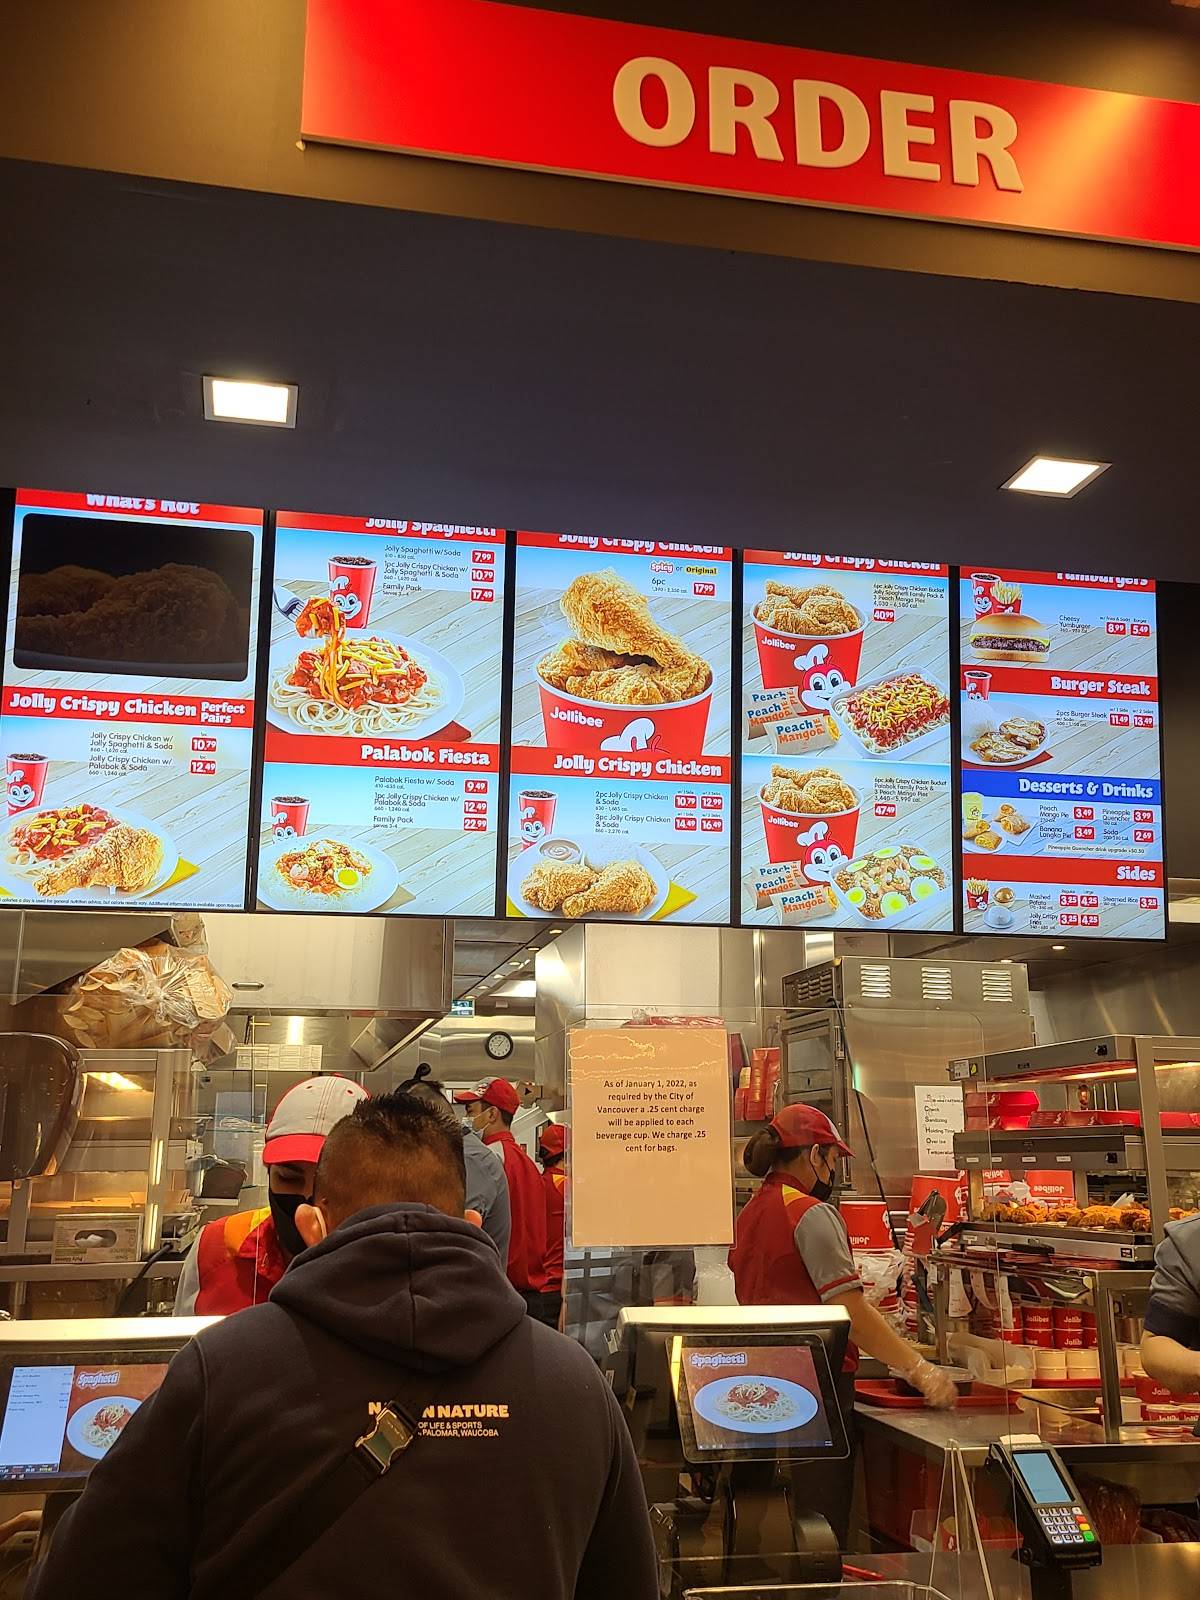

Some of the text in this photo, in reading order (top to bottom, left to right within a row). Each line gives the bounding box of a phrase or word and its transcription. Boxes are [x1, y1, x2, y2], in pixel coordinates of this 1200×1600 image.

[613, 56, 1024, 192] ORDER
[475, 552, 491, 562] 7.99
[400, 569, 432, 577] Spaghetti
[472, 570, 493, 580] 10.79
[652, 577, 666, 586] 6pc
[382, 583, 404, 591] Family
[694, 584, 713, 594] 17.99
[472, 590, 492, 600] 17.49
[874, 610, 893, 620] 40.99
[1060, 615, 1080, 624] Cheesy
[1108, 623, 1124, 633] 8.99
[1133, 625, 1148, 634] 5.49
[761, 636, 796, 651] Jollibee
[1051, 677, 1150, 696] Burger Steak
[10, 693, 197, 717] Jolly Crispy Chicken
[201, 702, 245, 715] Perfect
[748, 703, 781, 718] Peach
[201, 713, 232, 724] Pairs
[550, 707, 603, 728] Jollibee
[750, 710, 784, 726] Mango
[1111, 715, 1128, 724] 11.49
[1134, 716, 1152, 726] 13.49
[776, 720, 813, 734] Peach
[91, 732, 106, 740] Jolly
[109, 732, 130, 741] Crispy
[133, 733, 161, 742] Chicken
[778, 729, 817, 743] Mango
[90, 740, 106, 748] Jolly
[108, 741, 145, 750] Spaghetti
[193, 739, 216, 750] 10.79
[361, 744, 490, 765] Palabok Fiesta
[89, 755, 105, 763] Jolly
[108, 756, 129, 765] Crispy
[132, 757, 160, 765] Chicken
[191, 762, 216, 773] 12.49
[554, 755, 722, 777] Jolly Crispy Chicken
[374, 776, 403, 784] Palabok
[404, 777, 425, 785] Fiesta
[437, 778, 455, 786] Soda
[467, 782, 485, 792] 9.49
[1019, 779, 1153, 799] Desserts & Drinks
[375, 792, 385, 800] 1pc
[386, 793, 402, 801] Jolly
[402, 794, 422, 802] Crispy
[595, 791, 607, 799] 2pc
[608, 792, 622, 800] Jolly
[623, 792, 645, 801] Crispy
[676, 797, 695, 806] 10.79
[702, 798, 721, 807] 12.99
[464, 802, 486, 813] 12.49
[876, 806, 895, 815] 47.49
[1076, 808, 1092, 818] 3.49
[1135, 811, 1151, 821] 3.99
[374, 816, 413, 824] Family Pack
[609, 814, 623, 822] Jolly
[625, 815, 645, 823] Crispy
[768, 816, 799, 828] Jollibee
[464, 819, 486, 830] 22.99
[676, 819, 695, 829] 14.49
[702, 820, 721, 830] 16.49
[1076, 828, 1092, 837] 3.49
[1136, 831, 1152, 841] 2.69
[1117, 866, 1156, 881] Sides
[756, 876, 785, 890] Peach
[781, 891, 814, 905] Peach
[1061, 896, 1077, 905] 3.25
[1081, 897, 1097, 906] 4.25
[1141, 898, 1156, 908] 3.25
[783, 899, 818, 913] Mango
[1061, 915, 1077, 924] 3.25
[1082, 916, 1097, 925] 4.25
[625, 1080, 655, 1089] January
[657, 1080, 664, 1088] 1,
[666, 1080, 686, 1088] 2022,
[608, 1092, 694, 1102] required by the City of
[679, 1105, 705, 1114] charge
[624, 1118, 633, 1126] be
[635, 1118, 664, 1127] applied
[596, 1132, 632, 1140] beverage
[652, 1131, 665, 1139] We
[667, 1131, 692, 1140] charge
[644, 1144, 656, 1152] for
[657, 1144, 677, 1153] bags.
[1033, 1185, 1065, 1194] Jollibee
[691, 1353, 746, 1367] Spaghetti
[78, 1372, 119, 1387] Spaghetti
[437, 1404, 510, 1418] NATURE
[429, 1422, 445, 1430] LIFE
[452, 1421, 482, 1429] SPORTS
[422, 1429, 460, 1438] PALOMAR,
[461, 1429, 499, 1437] WAUCOBA
